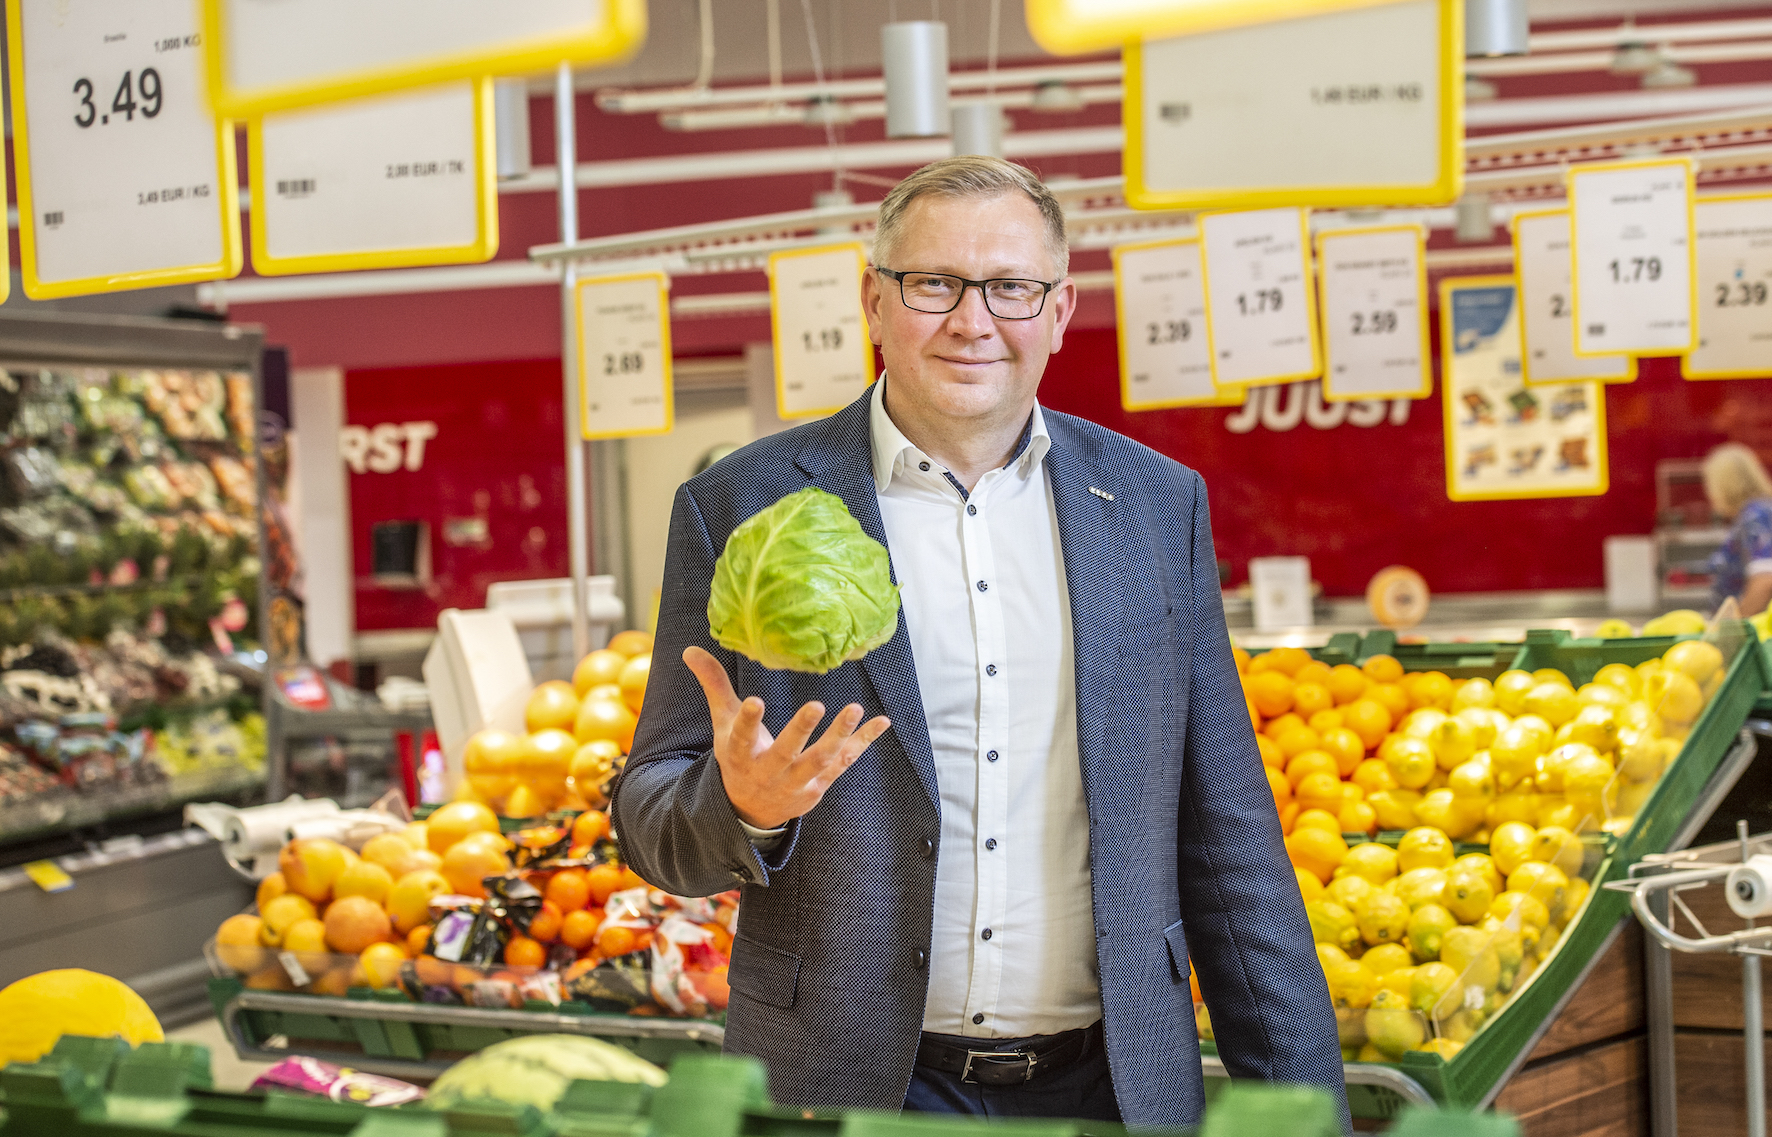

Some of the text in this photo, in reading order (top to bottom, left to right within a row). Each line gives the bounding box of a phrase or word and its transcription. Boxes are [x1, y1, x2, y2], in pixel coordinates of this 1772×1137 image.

[72, 66, 164, 129] 3.49
[412, 161, 438, 178] EUR
[160, 187, 184, 203] EUR
[1609, 256, 1663, 284] 1.79
[1236, 287, 1284, 317] 1.79
[1715, 281, 1768, 308] 2.39
[1350, 310, 1399, 336] 2.59
[801, 327, 845, 353] 1.19
